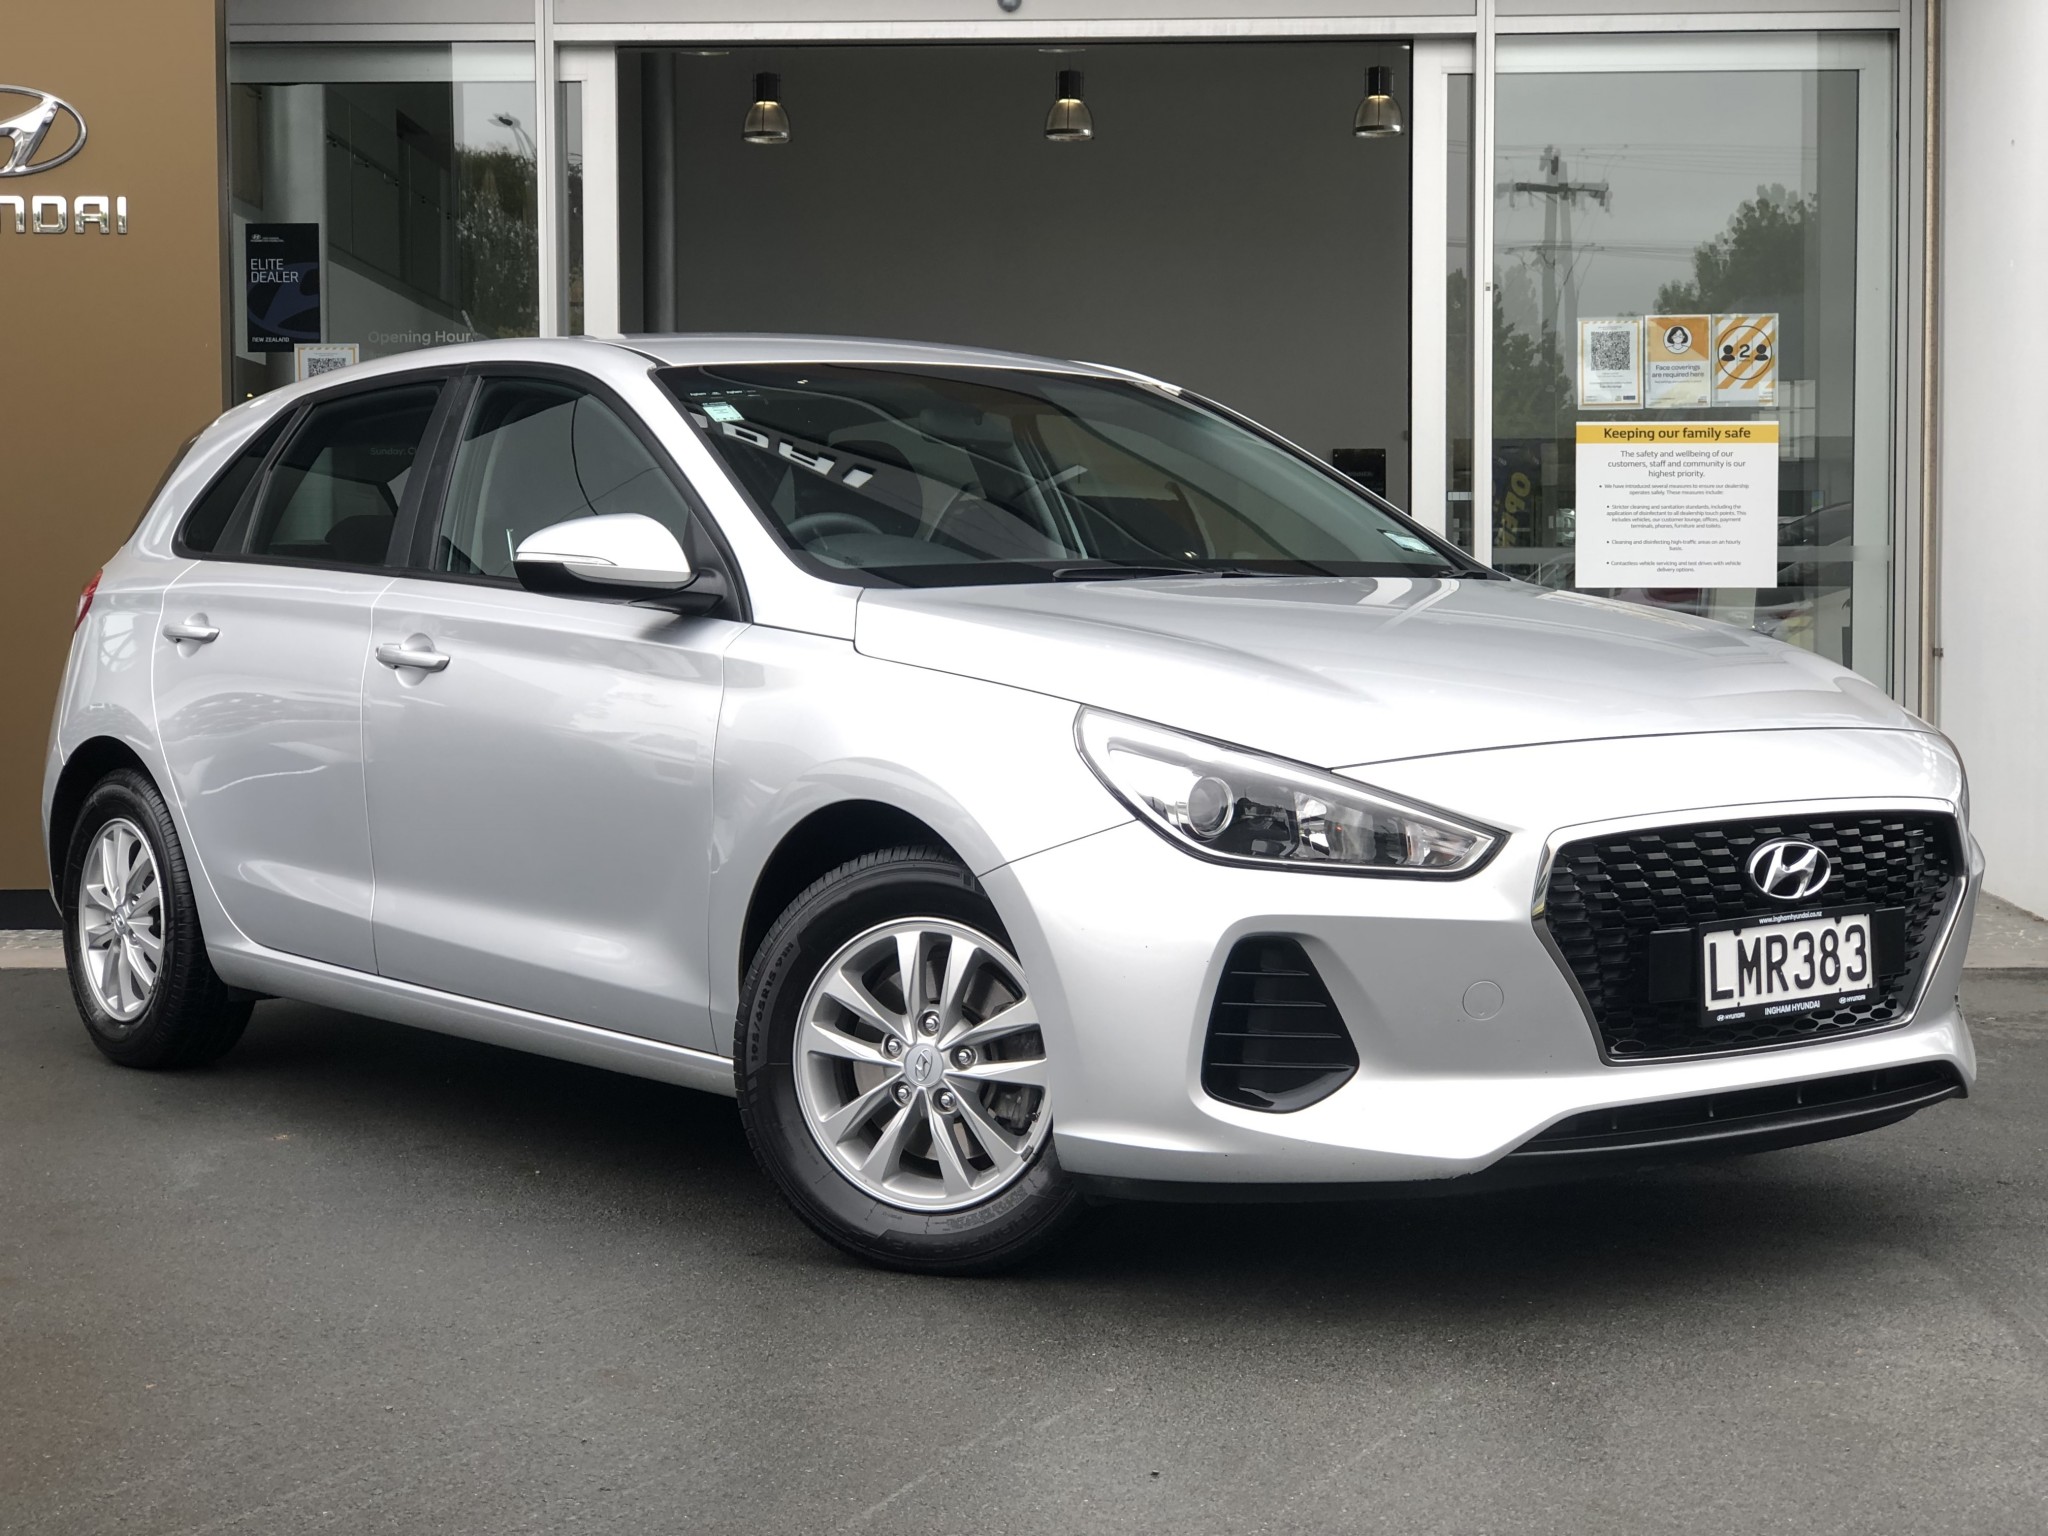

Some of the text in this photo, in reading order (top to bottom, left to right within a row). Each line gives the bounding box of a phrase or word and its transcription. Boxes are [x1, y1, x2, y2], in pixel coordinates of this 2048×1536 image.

[250, 258, 284, 271] ELITE
[250, 271, 299, 283] DEALER
[368, 330, 475, 346] Opening Hour
[1739, 343, 1750, 358] 2
[1603, 427, 1751, 442] Keeping our family safe
[1621, 450, 1634, 458] The
[1636, 450, 1658, 460] safety
[1660, 450, 1673, 458] and
[1675, 450, 1710, 460] wellbeing
[1711, 450, 1720, 458] of
[1608, 461, 1648, 469] customers,
[1649, 460, 1666, 468] staff
[1667, 460, 1681, 468] and
[1683, 460, 1724, 470] community
[1726, 460, 1732, 468] is
[1648, 469, 1705, 480] highest priority.
[1709, 923, 1868, 1001] LMR383
[1764, 1000, 1821, 1016] INGHAM HYUNDAI
